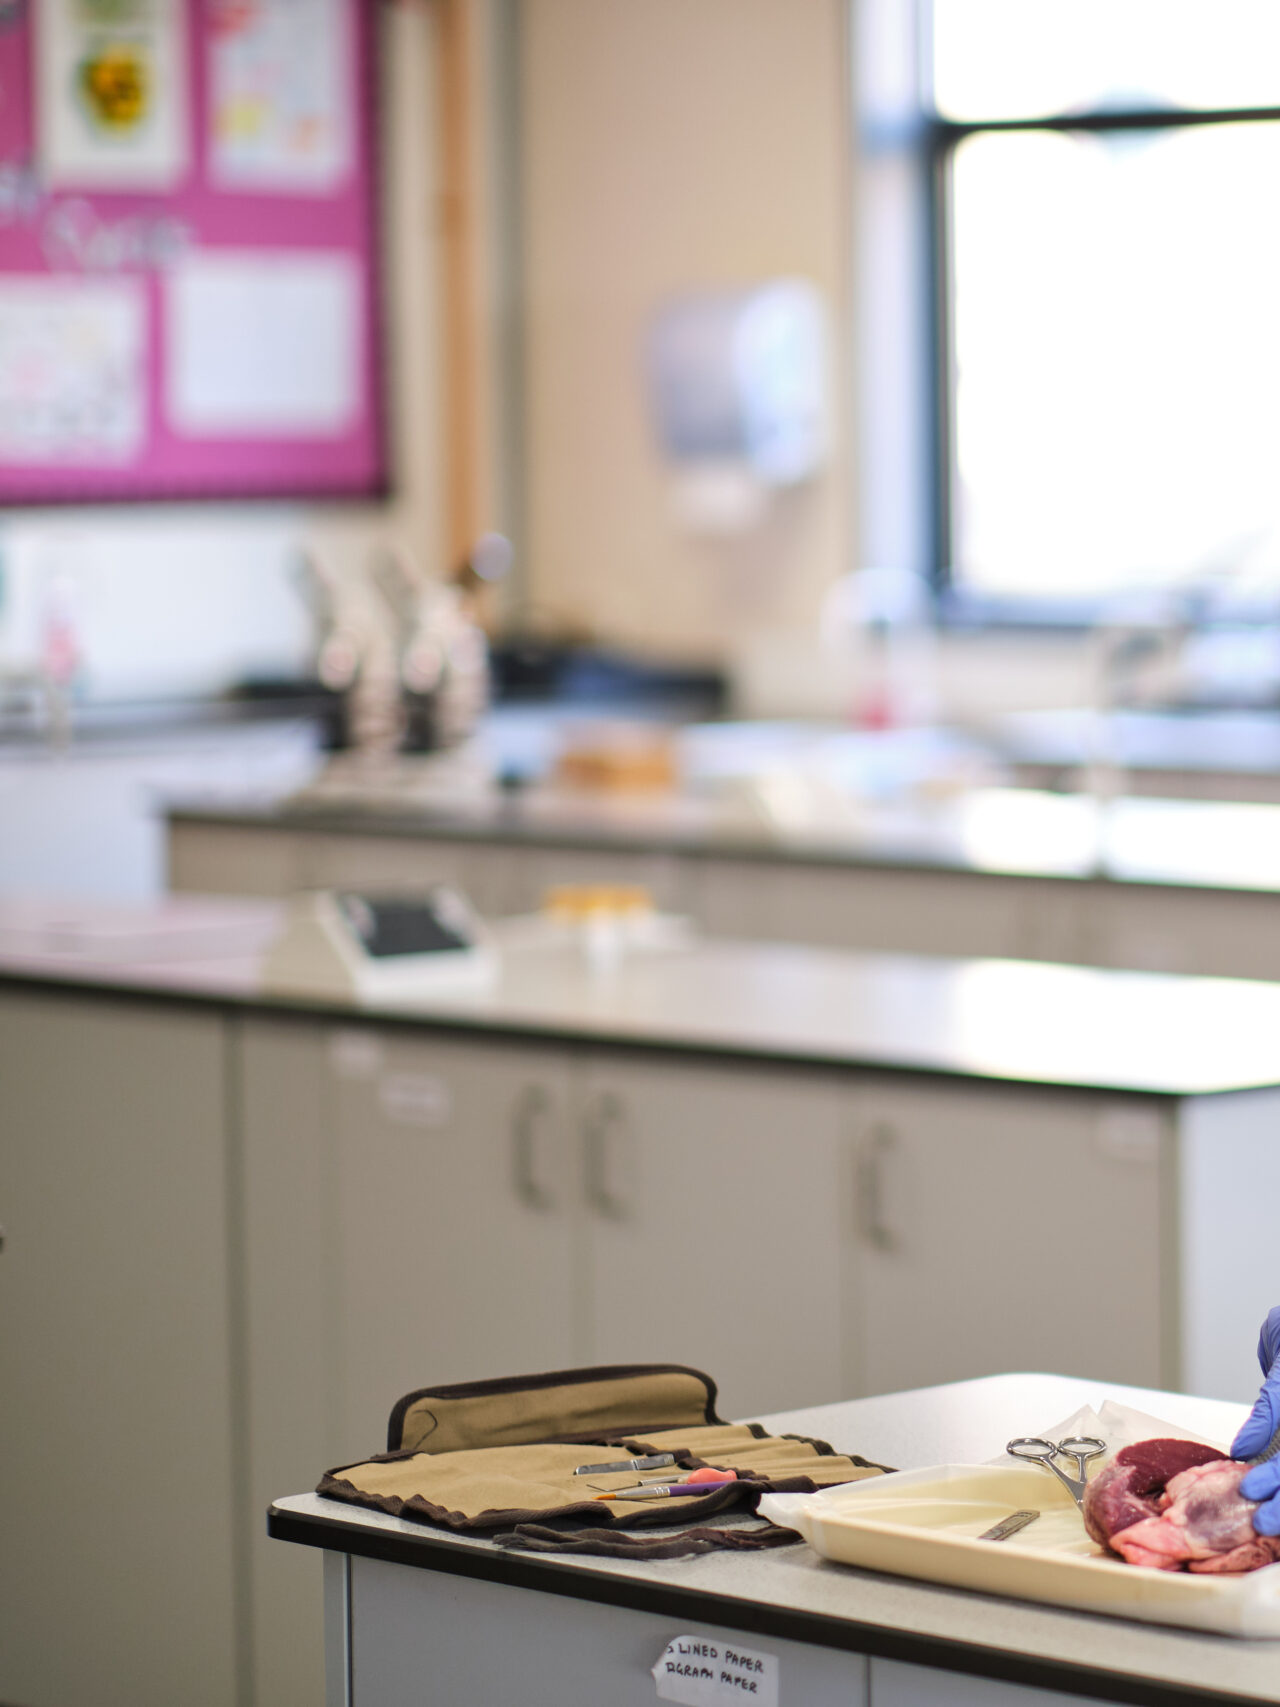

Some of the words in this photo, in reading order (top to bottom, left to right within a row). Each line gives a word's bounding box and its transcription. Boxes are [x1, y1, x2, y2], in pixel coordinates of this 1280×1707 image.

[678, 1643, 718, 1658] LINED
[725, 1650, 763, 1673] PAPER
[720, 1671, 757, 1693] PAPER
